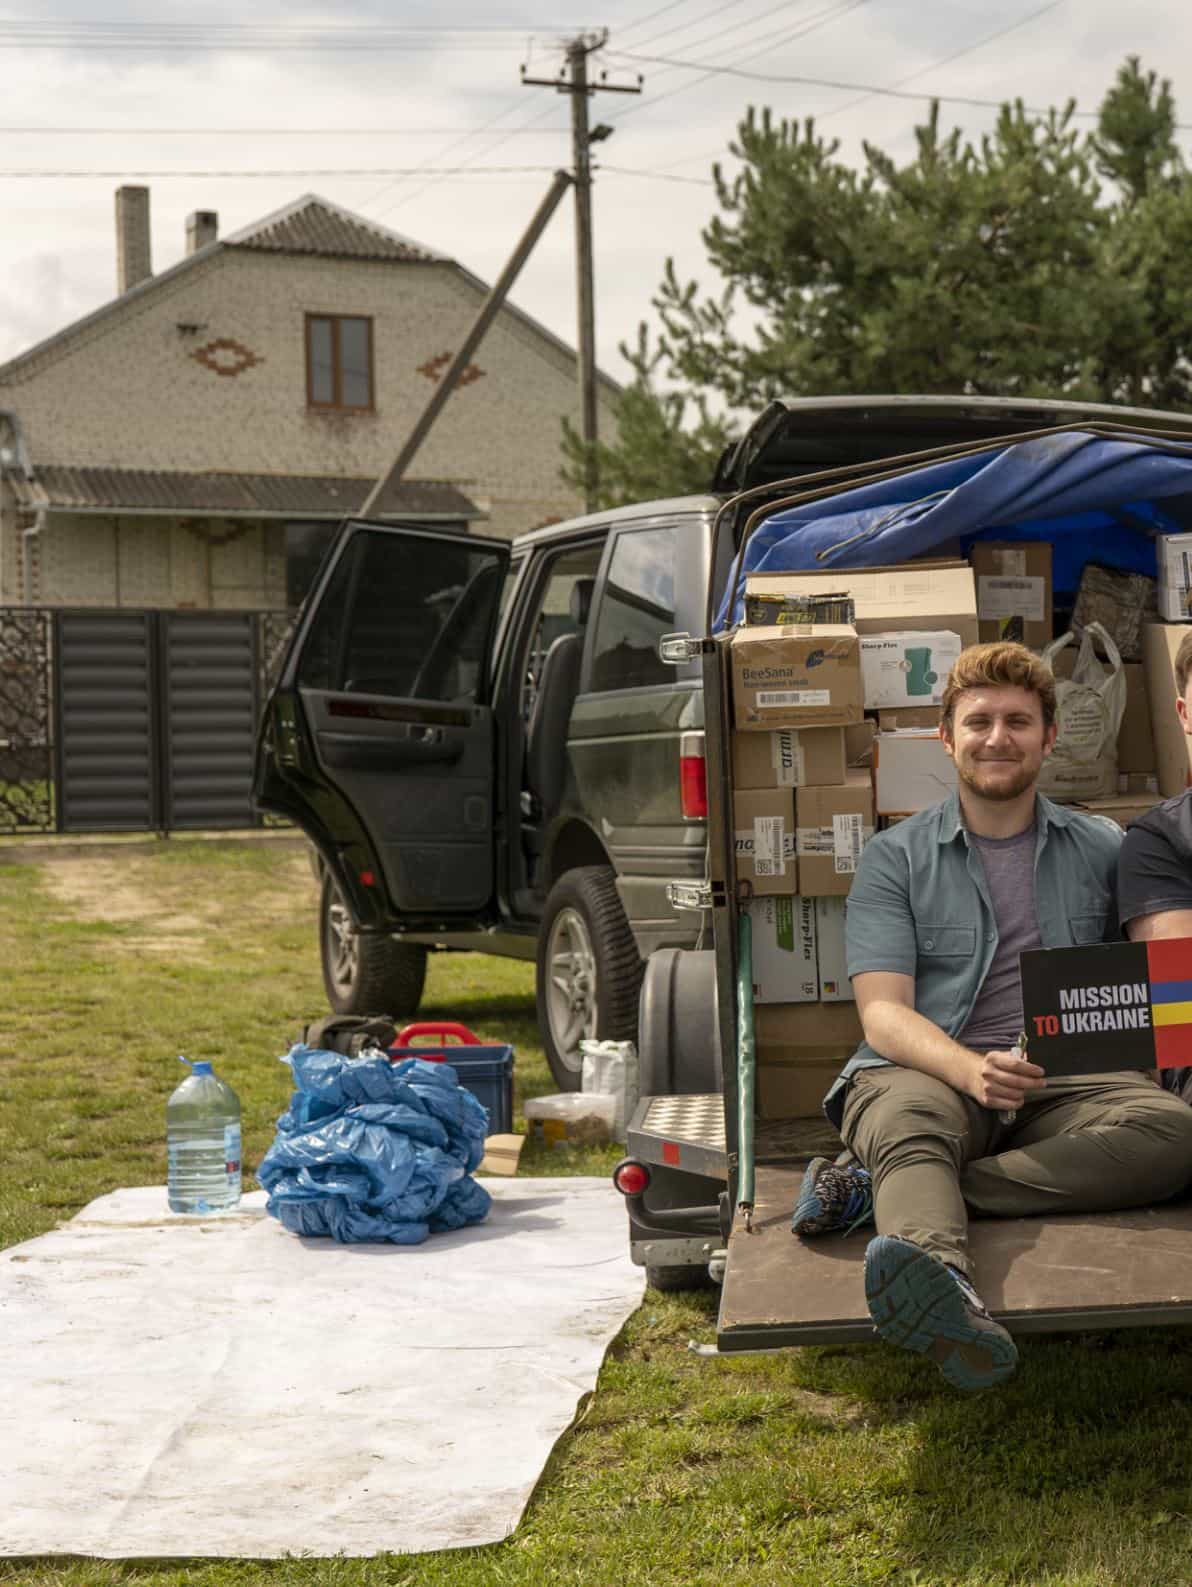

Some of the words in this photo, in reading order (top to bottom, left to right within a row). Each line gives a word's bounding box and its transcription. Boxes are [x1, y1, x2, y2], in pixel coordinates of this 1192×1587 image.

[1059, 983, 1148, 1010] MISSION
[1033, 1014, 1058, 1037] TO
[1062, 1007, 1150, 1034] UKRAINE
